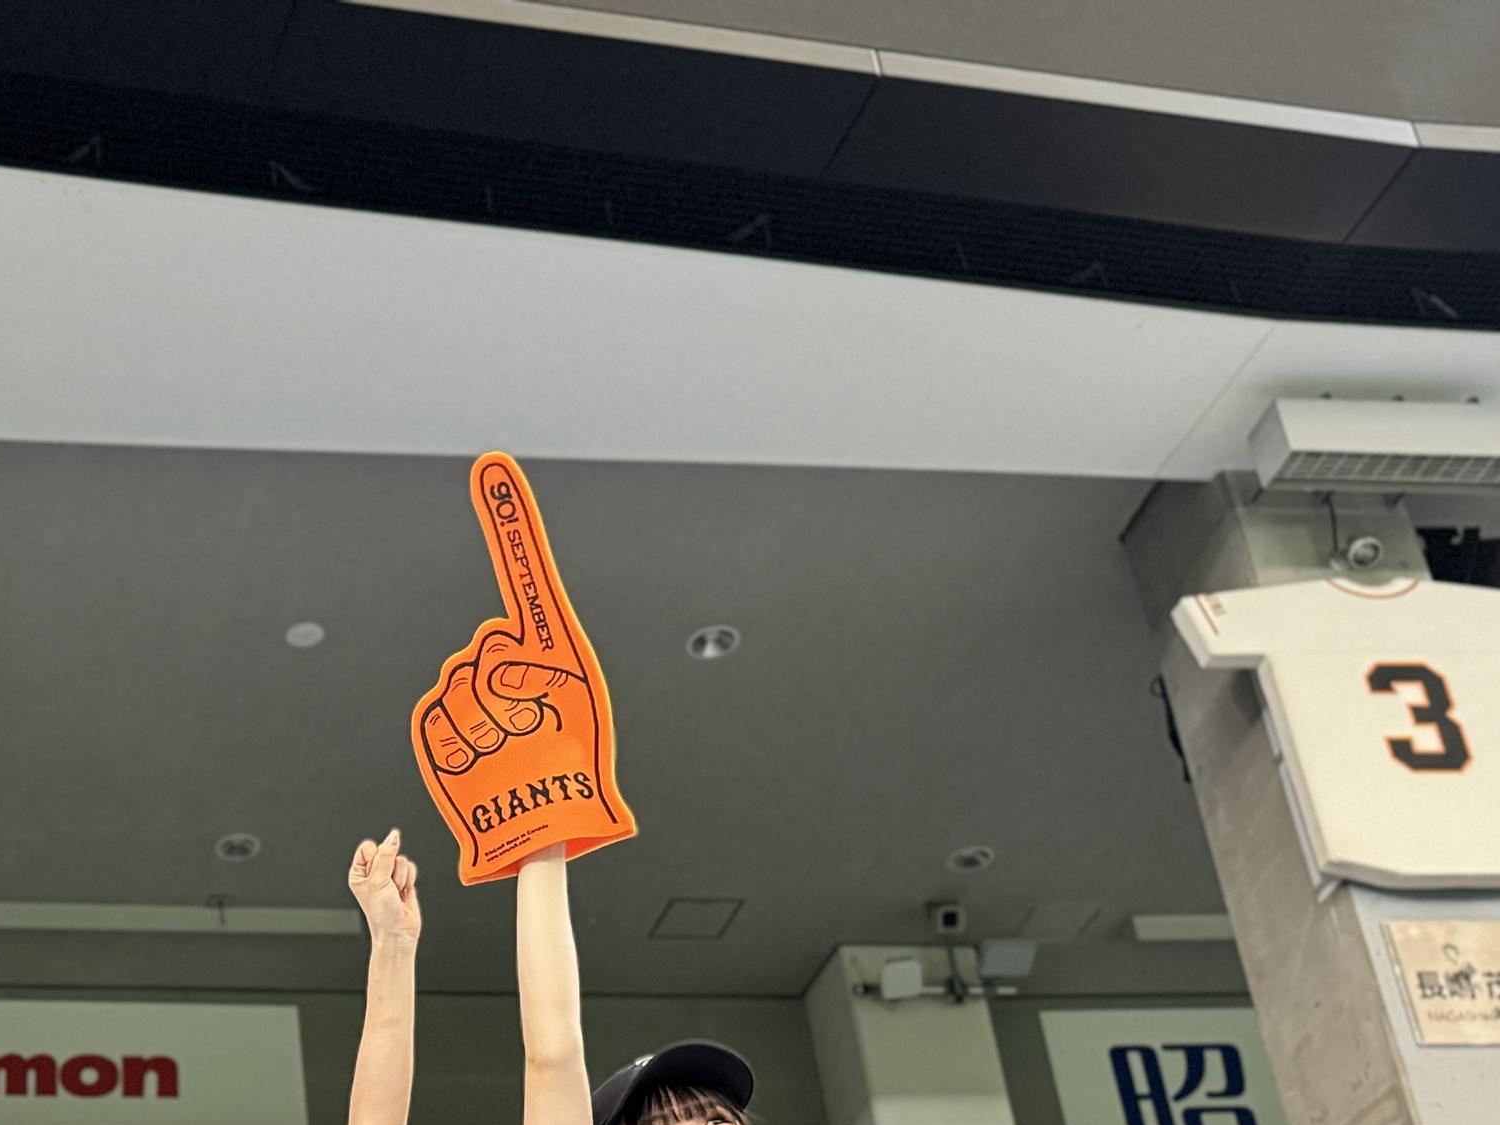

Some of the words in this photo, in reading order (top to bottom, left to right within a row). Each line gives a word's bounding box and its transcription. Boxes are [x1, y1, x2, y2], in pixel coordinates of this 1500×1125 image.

[506, 528, 554, 654] SEPTEMBER
[1364, 661, 1474, 775] 3
[470, 771, 595, 835] GIANTS
